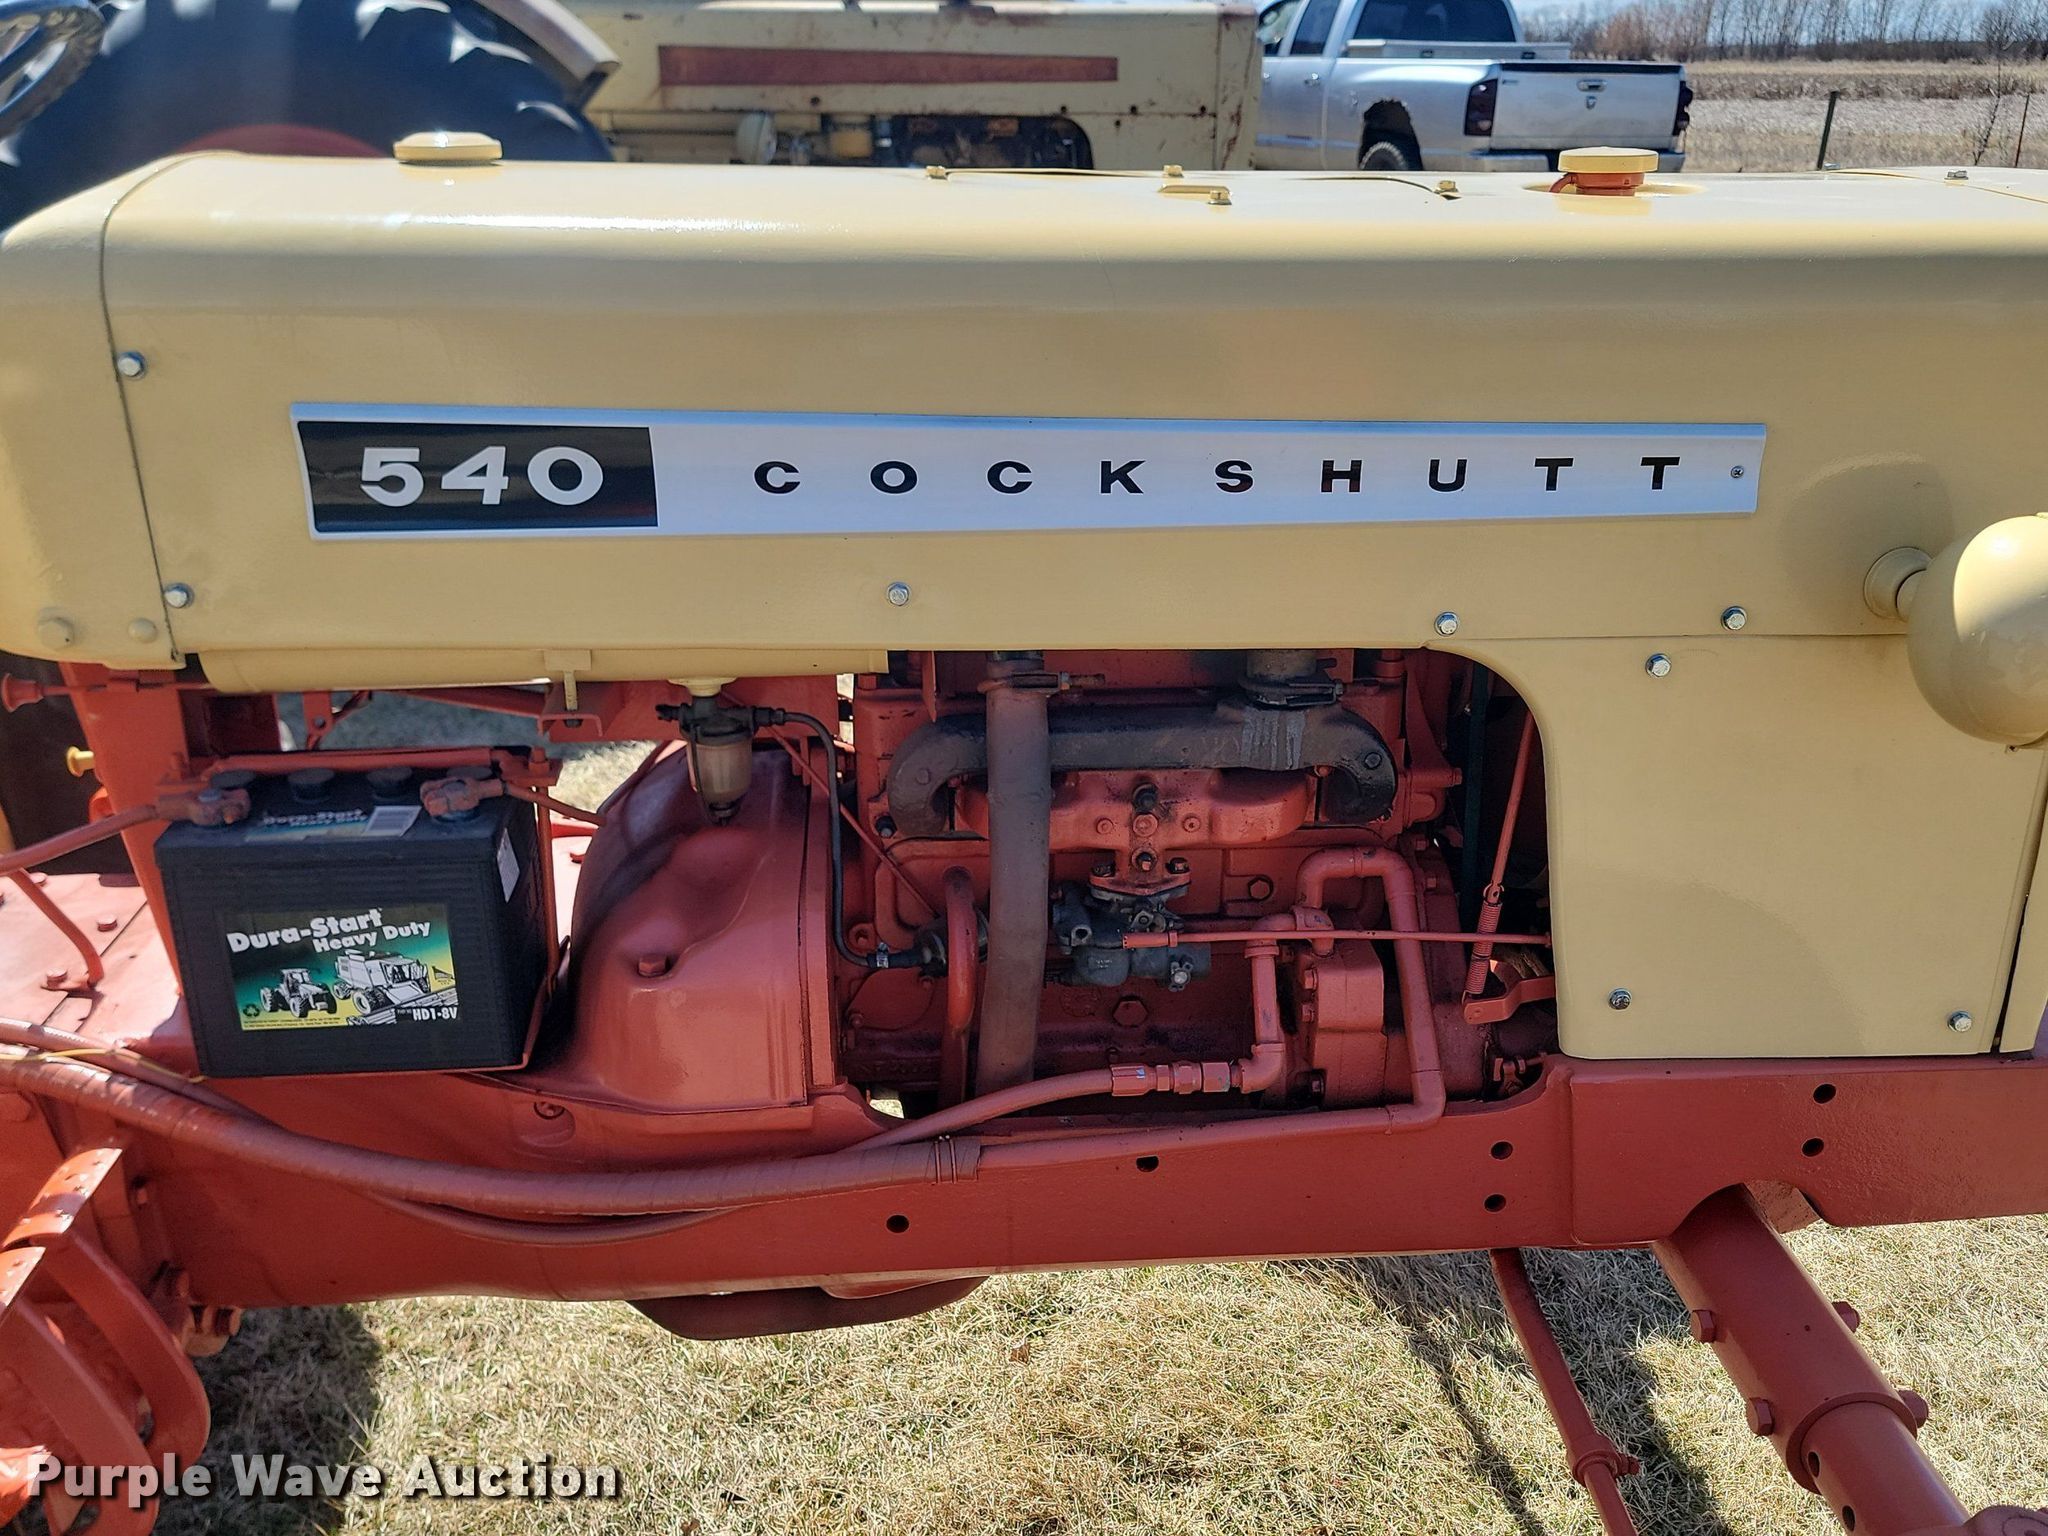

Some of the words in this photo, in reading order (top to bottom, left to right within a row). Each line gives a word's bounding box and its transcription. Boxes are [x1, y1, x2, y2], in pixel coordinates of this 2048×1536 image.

[359, 446, 604, 507] 540
[753, 456, 1681, 494] COCKSHUTT
[226, 908, 383, 953] Dura-Start
[312, 931, 378, 953] Heavy
[382, 921, 431, 941] Duty
[412, 1006, 458, 1022] HD1-8V
